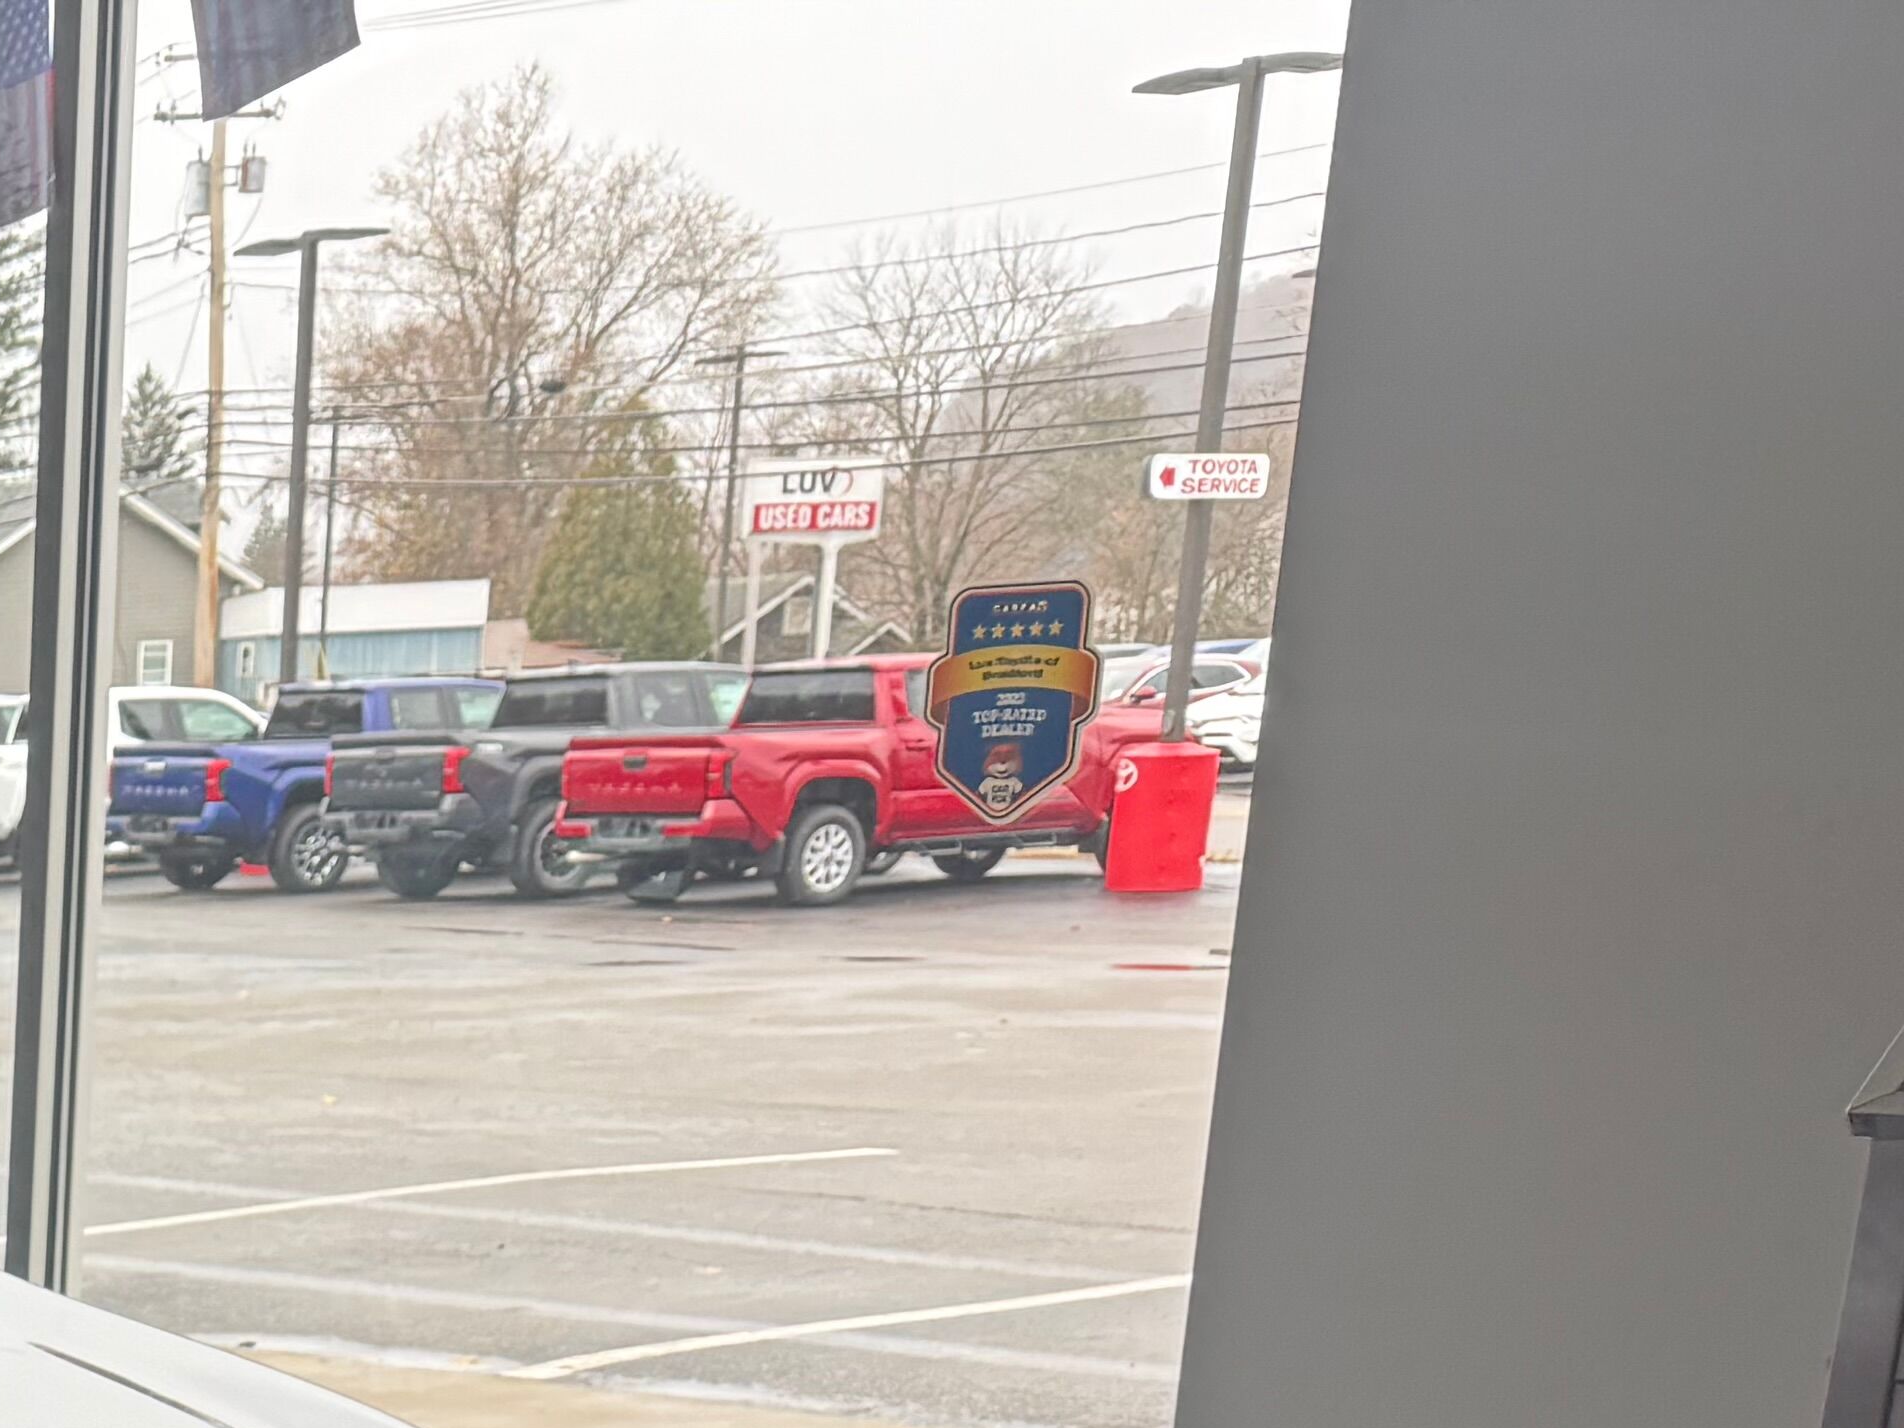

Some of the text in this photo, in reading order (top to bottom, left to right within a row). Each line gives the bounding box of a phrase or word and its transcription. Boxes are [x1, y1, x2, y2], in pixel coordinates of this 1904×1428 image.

[1188, 459, 1258, 475] TOYOTA
[1180, 478, 1261, 494] SERVICE
[758, 503, 870, 529] USED CARS
